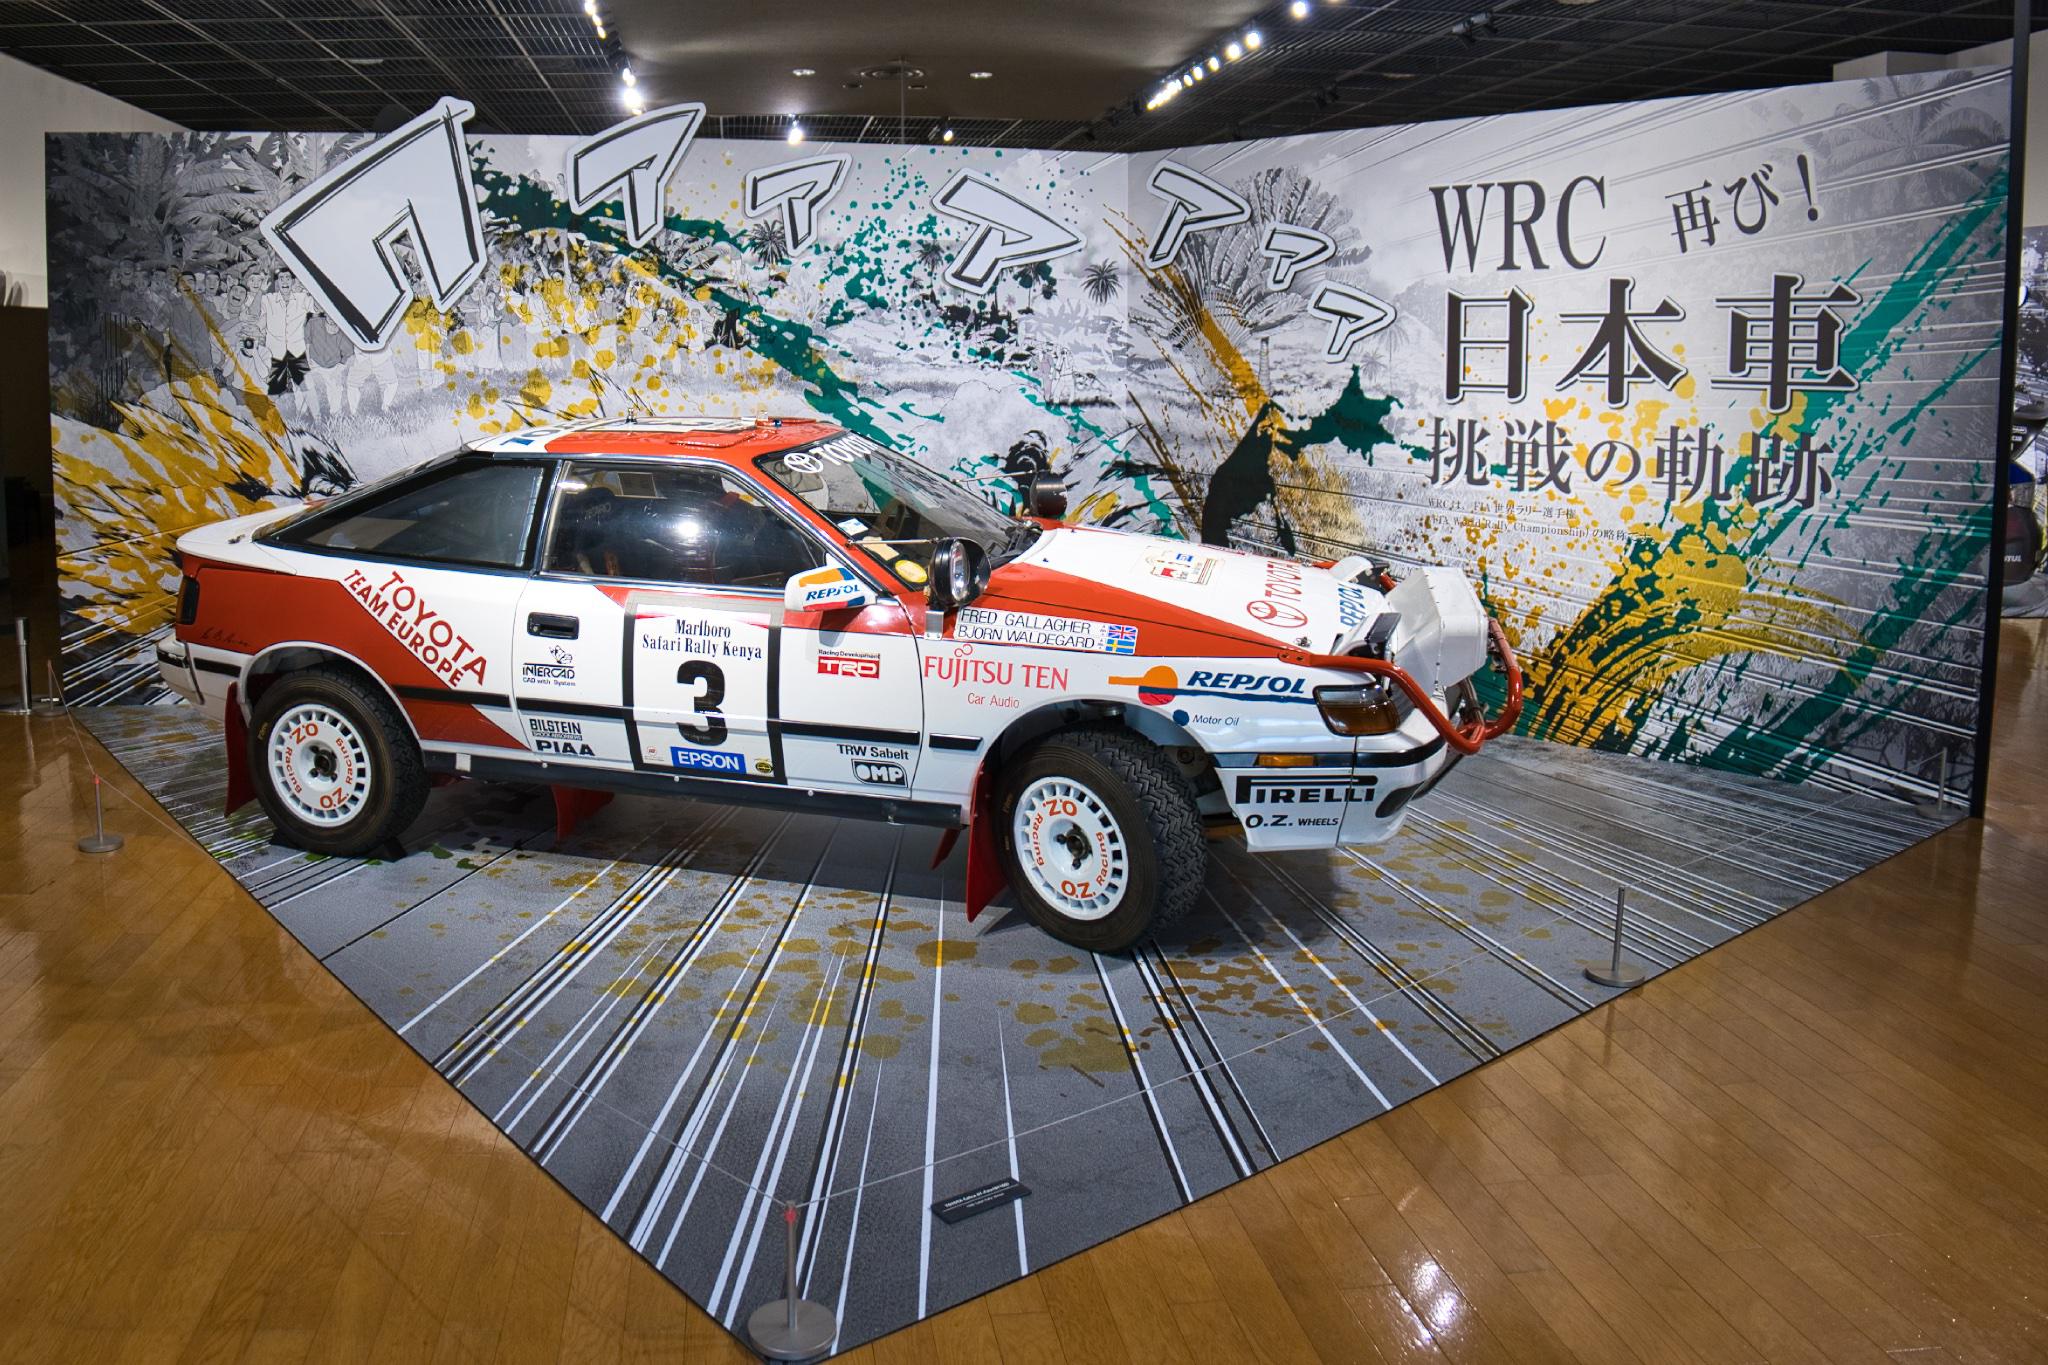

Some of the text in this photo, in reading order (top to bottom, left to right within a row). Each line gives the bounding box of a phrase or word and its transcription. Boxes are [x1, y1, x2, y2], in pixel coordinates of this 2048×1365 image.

[1429, 175, 1607, 274] WRC
[1444, 273, 1863, 414] 日本車
[1425, 416, 1836, 509] 挑戦の軌跡
[806, 584, 861, 601] REPSOL
[344, 569, 464, 687] TEAM EUROPE
[379, 571, 487, 686] TOYOTA
[674, 619, 731, 639] Marlboro
[960, 608, 1092, 634] FRED GALLAGHER
[642, 634, 762, 661] Safari Rally Kenya
[1006, 630, 1095, 649] WALDEGARD
[522, 664, 576, 680] INTERCAD
[819, 659, 878, 678] TRD
[924, 643, 1069, 691] FUJITSU TEN
[1186, 670, 1307, 694] REPSOL
[677, 660, 728, 746] 3
[967, 692, 1020, 709] Car Audio
[529, 719, 582, 735] BILSTEIN
[1193, 714, 1240, 727] Motor Oil
[536, 739, 596, 757] PIAA
[837, 744, 909, 760] TRW Sabelt
[284, 746, 303, 794] Racing
[335, 738, 353, 785] Racing
[678, 751, 740, 771] EPSON
[855, 764, 904, 782] OMP
[1236, 775, 1379, 805] PIRELLI
[1245, 814, 1340, 828] O.Z. WHEELS
[1032, 813, 1045, 867] Racing
[1095, 831, 1109, 887] Racing
